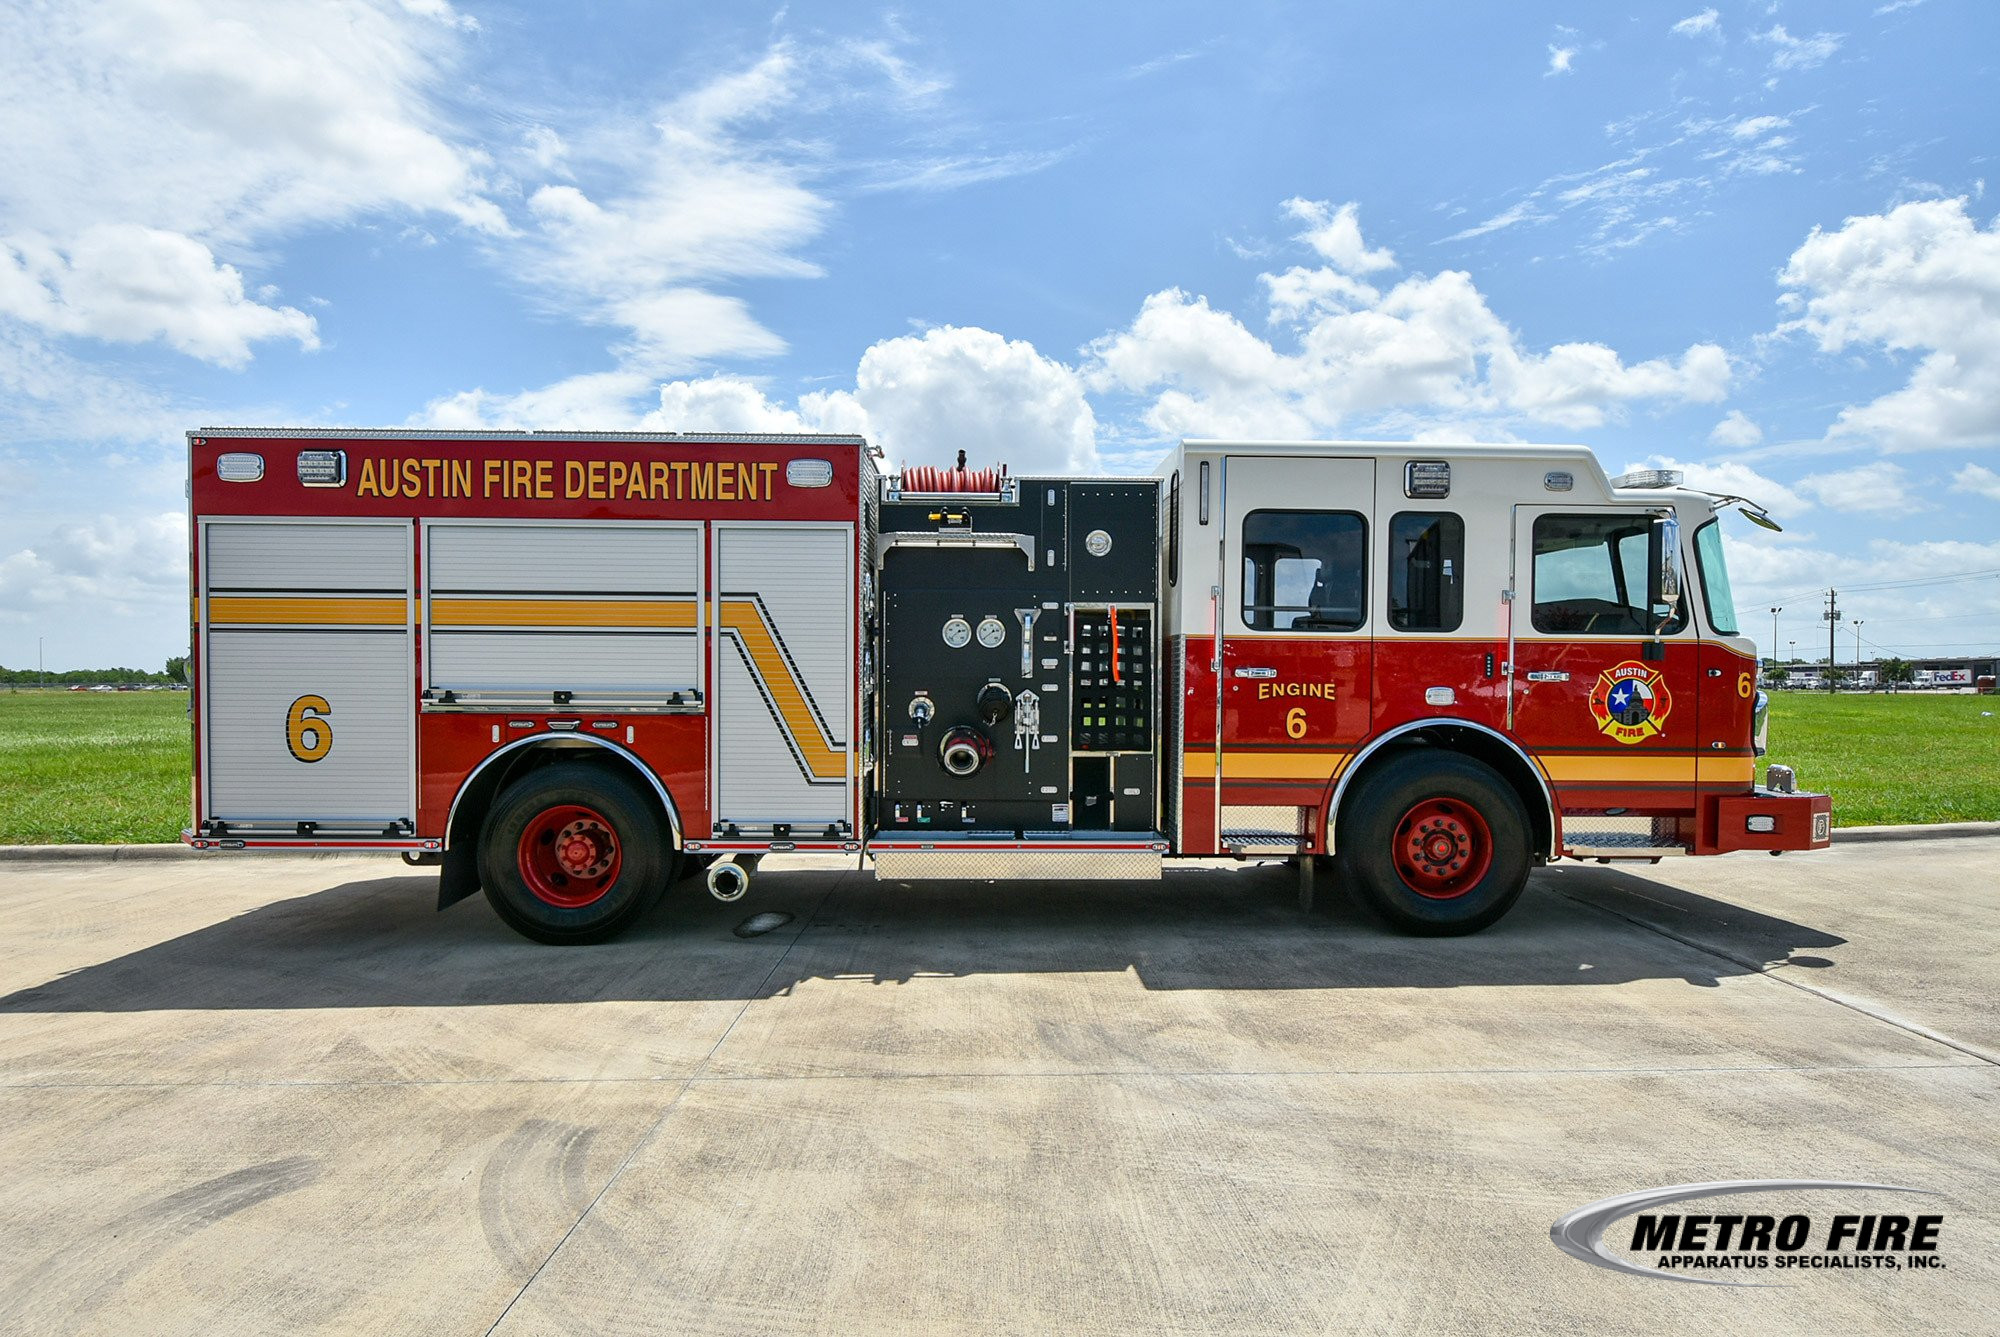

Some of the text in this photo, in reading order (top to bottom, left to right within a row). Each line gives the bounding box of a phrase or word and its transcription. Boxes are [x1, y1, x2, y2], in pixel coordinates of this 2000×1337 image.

[357, 458, 778, 500] AUSTIN FIRE DEPARTMENT
[1615, 667, 1648, 678] AUSTIN
[1934, 671, 1966, 681] FedEx
[1258, 683, 1336, 700] ENGINE
[1737, 672, 1751, 698] 6
[286, 694, 333, 763] 6
[1286, 707, 1307, 739] 6
[1615, 727, 1645, 737] FIRE
